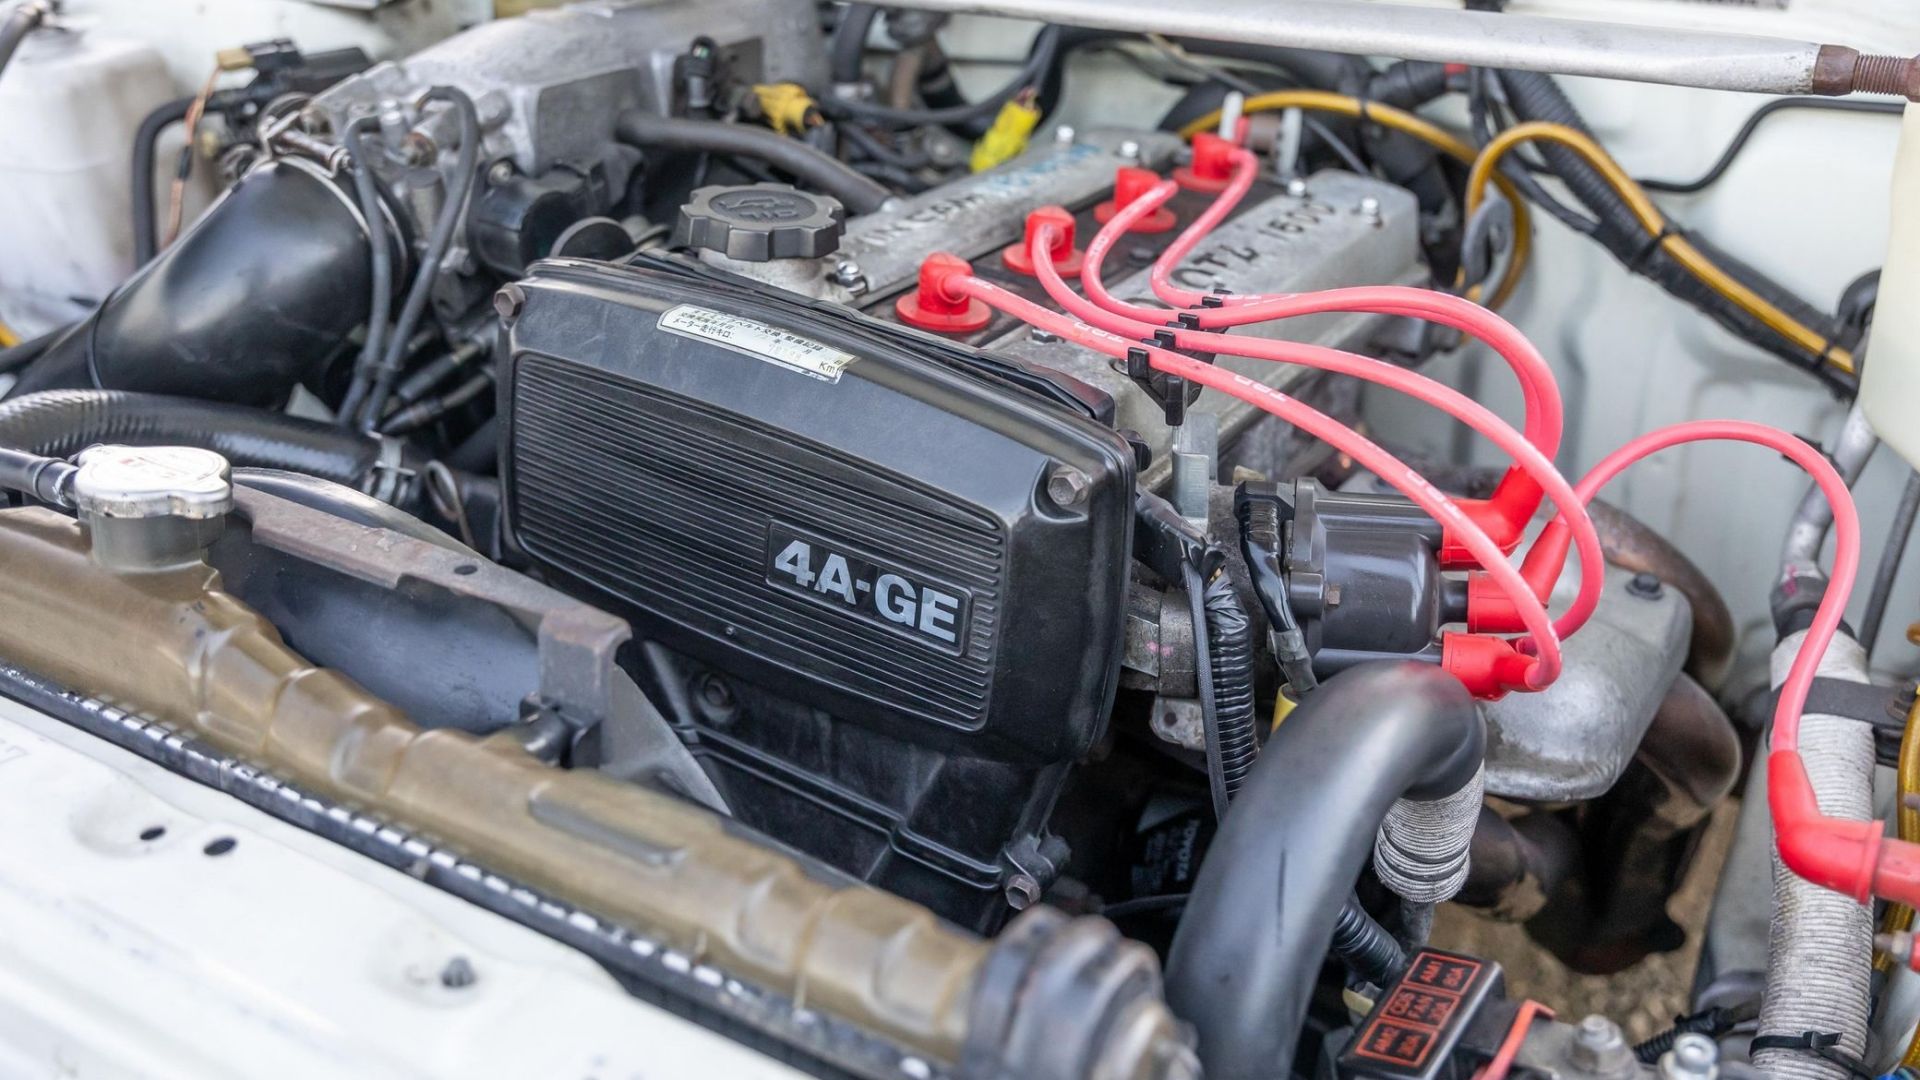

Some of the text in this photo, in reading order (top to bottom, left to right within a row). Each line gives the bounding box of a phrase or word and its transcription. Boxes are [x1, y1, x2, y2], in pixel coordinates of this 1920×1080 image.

[1074, 321, 1126, 344] TRD
[818, 359, 837, 375] Km
[1234, 373, 1287, 403] TRD
[774, 539, 960, 643] 4A-GE
